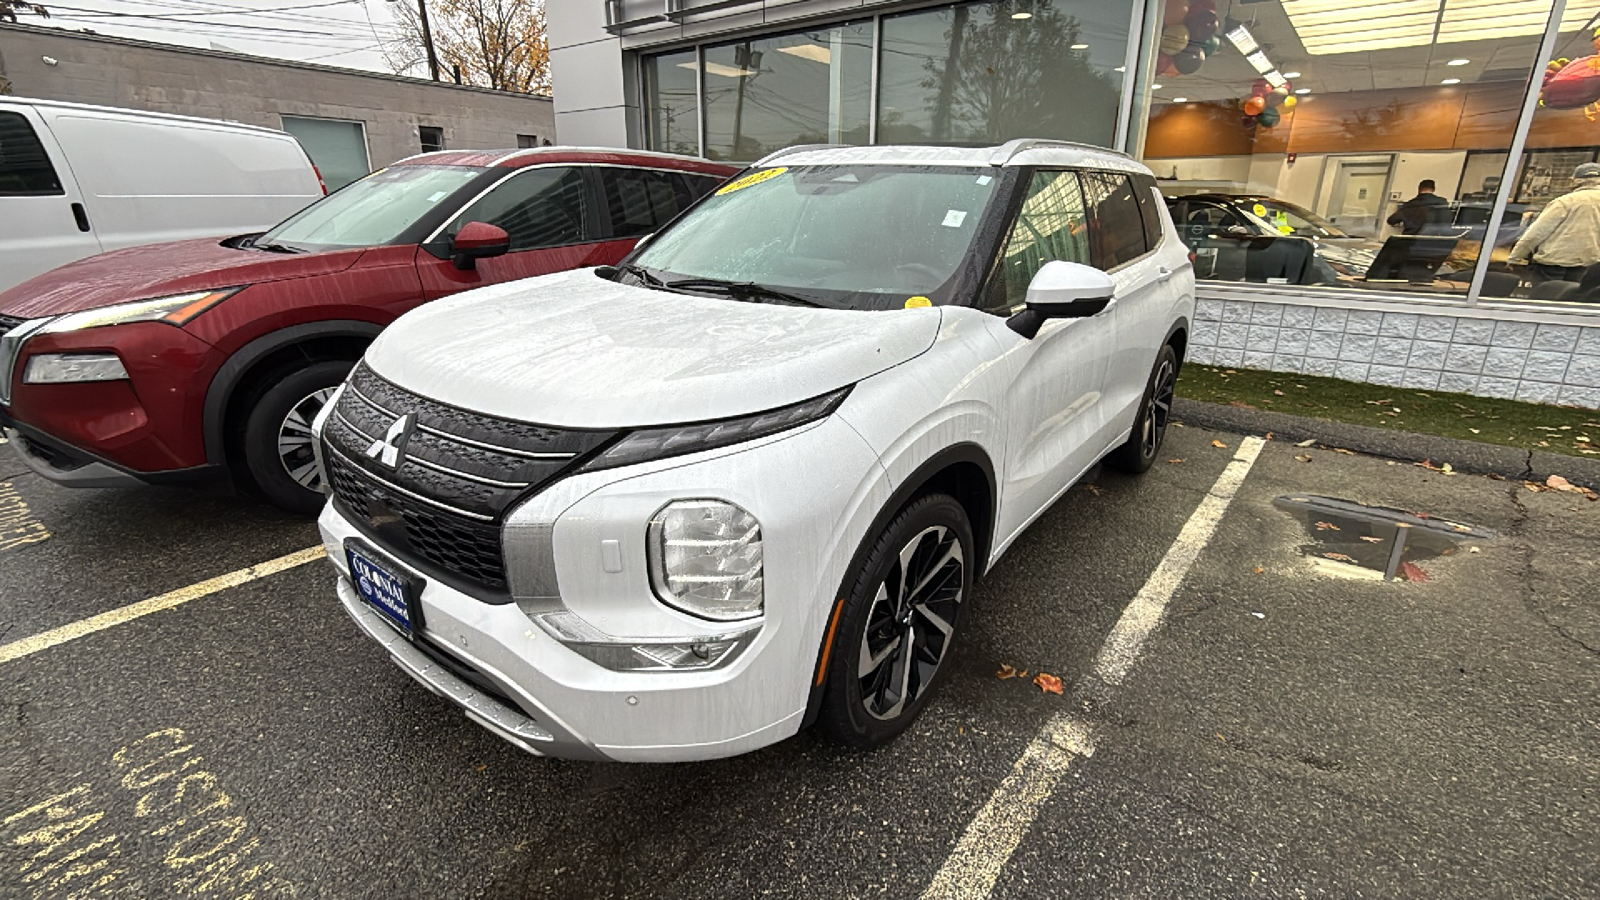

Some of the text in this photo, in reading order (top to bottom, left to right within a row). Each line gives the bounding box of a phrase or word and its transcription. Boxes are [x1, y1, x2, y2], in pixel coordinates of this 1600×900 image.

[353, 555, 408, 606] COLONIAL
[373, 586, 409, 621] Medford
[112, 727, 296, 900] CUSTOM
